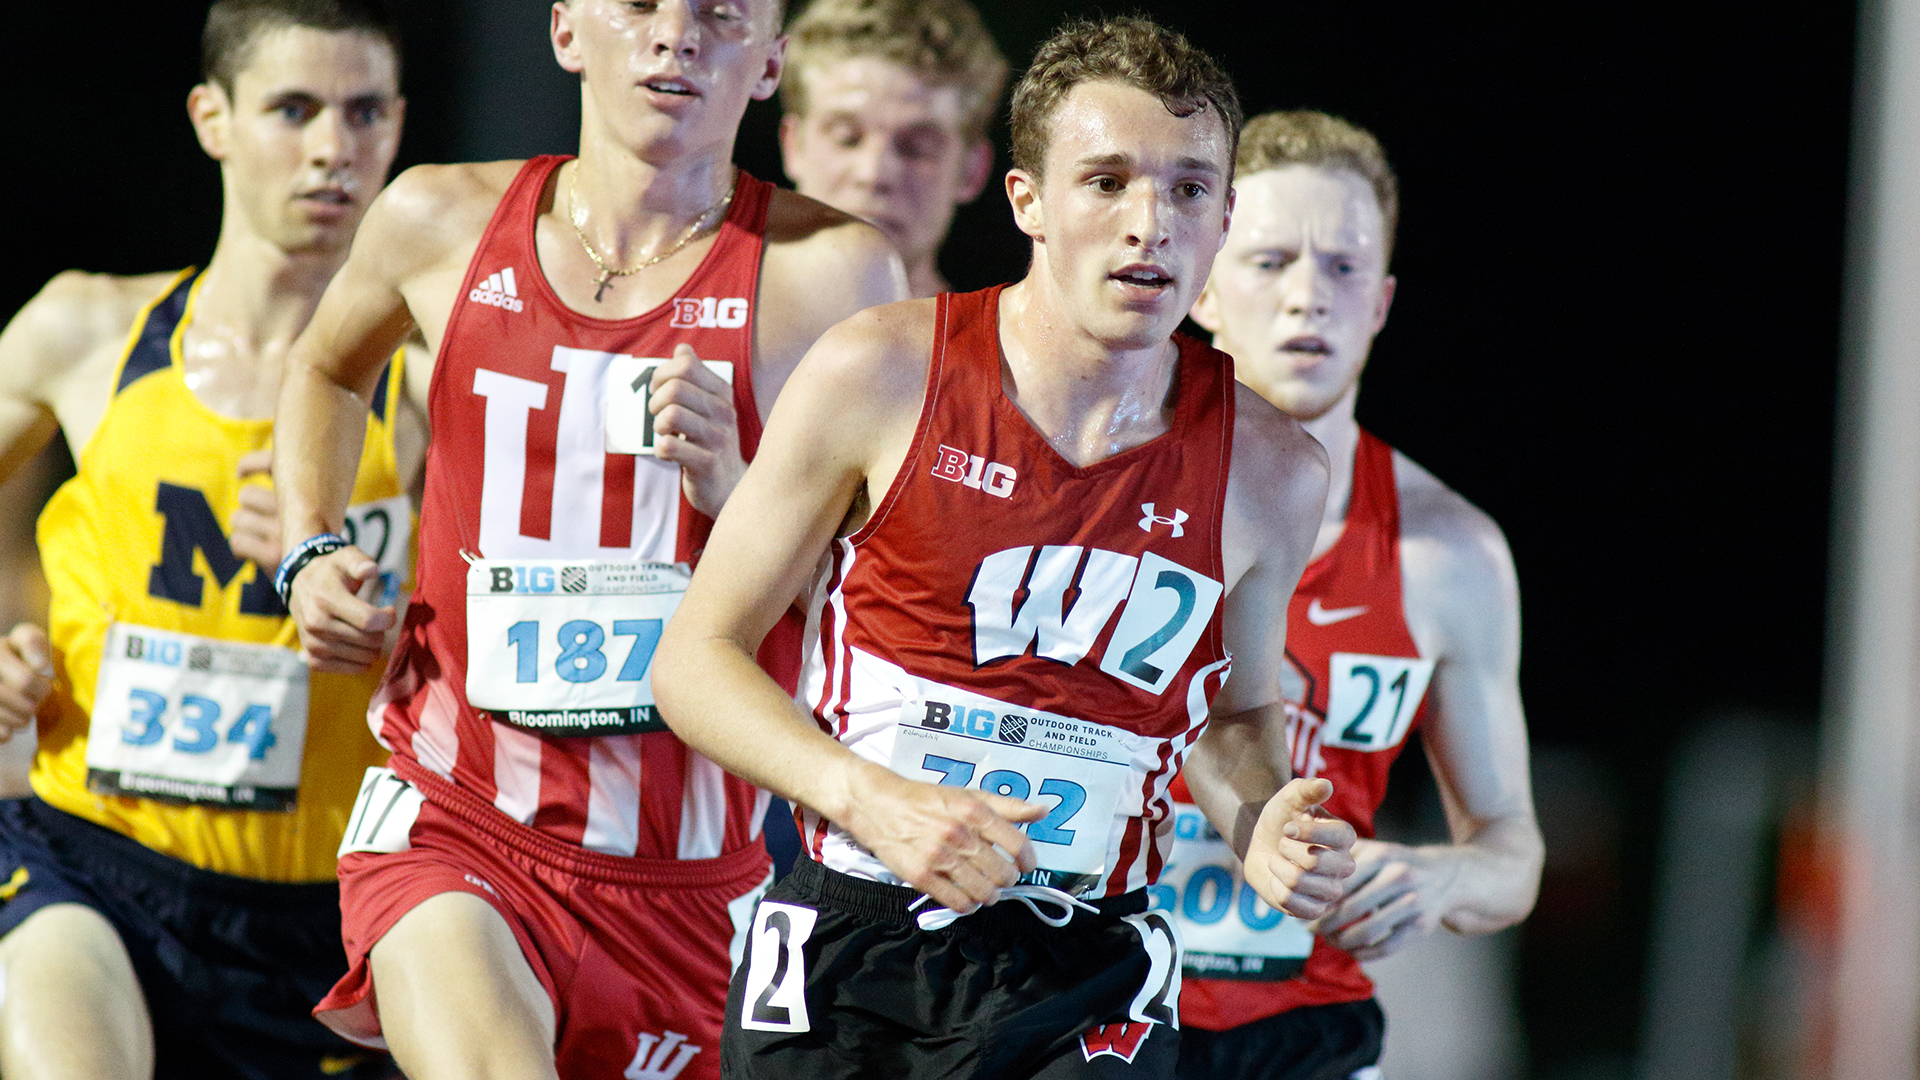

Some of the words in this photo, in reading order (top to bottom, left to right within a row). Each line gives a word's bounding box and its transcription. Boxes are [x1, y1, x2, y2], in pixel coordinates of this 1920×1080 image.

[469, 288, 524, 313] adidas
[631, 366, 657, 448] 1
[148, 481, 291, 617] M
[588, 564, 637, 572] OUTDOOR
[630, 574, 659, 582] FIELD
[961, 545, 1139, 671] W
[1119, 570, 1197, 685] 2
[507, 618, 664, 684] 187
[121, 687, 277, 761] 334
[508, 711, 625, 729] Bloomington,
[630, 709, 650, 722] IN
[1030, 717, 1079, 732] OUTDOOR
[1082, 726, 1113, 739] TRACK
[1044, 731, 1066, 741] AND
[1069, 735, 1097, 746] FIELD
[1341, 664, 1409, 743] 21
[1028, 739, 1108, 760] CHAMPIONSHIPS
[350, 772, 413, 846] 17
[1031, 870, 1051, 886] IN
[751, 910, 791, 1025] 2
[1142, 914, 1178, 1027] 2
